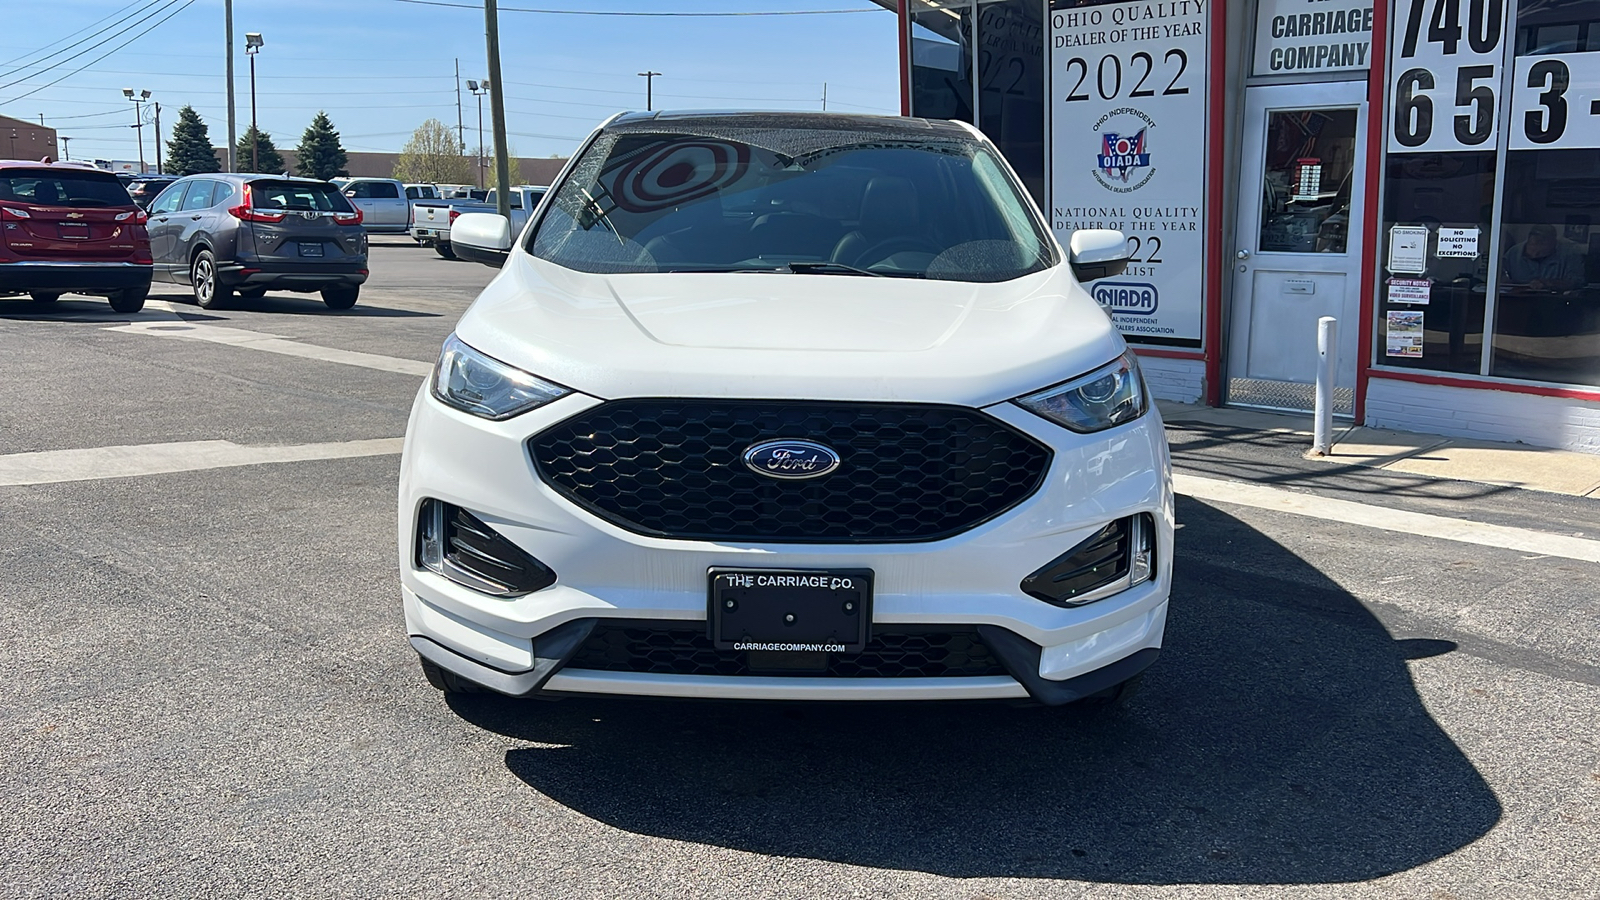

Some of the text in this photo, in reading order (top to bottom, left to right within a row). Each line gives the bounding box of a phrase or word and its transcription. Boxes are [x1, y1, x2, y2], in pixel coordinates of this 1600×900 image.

[1053, 10, 1103, 29] OHIO
[1112, 0, 1204, 25] QUALITY
[1271, 8, 1373, 38] CARRIAGE
[1055, 31, 1106, 48] DEALER
[1110, 29, 1128, 43] OF
[1131, 26, 1160, 41] THE
[1163, 22, 1202, 38] YEAR
[1270, 42, 1369, 70] COMPANY
[1065, 48, 1189, 102] 2022
[1092, 107, 1157, 132] OHIO INDEPENDENT
[1103, 155, 1141, 167] OIADA
[1054, 207, 1199, 219] NATIONAL QUALITY
[1056, 221, 1197, 231] DEALER OF THE YEAR
[1126, 236, 1163, 264] 22
[1123, 266, 1156, 277] LIST
[1096, 288, 1152, 308] NIADA
[1120, 316, 1158, 325] INDEPENDENT
[1135, 326, 1175, 334] ASSOCIATION
[767, 449, 827, 470] Ford
[726, 575, 855, 590] THE CARRIAGE CO.
[733, 642, 846, 652] CARRIAGECOMPANY.COM
